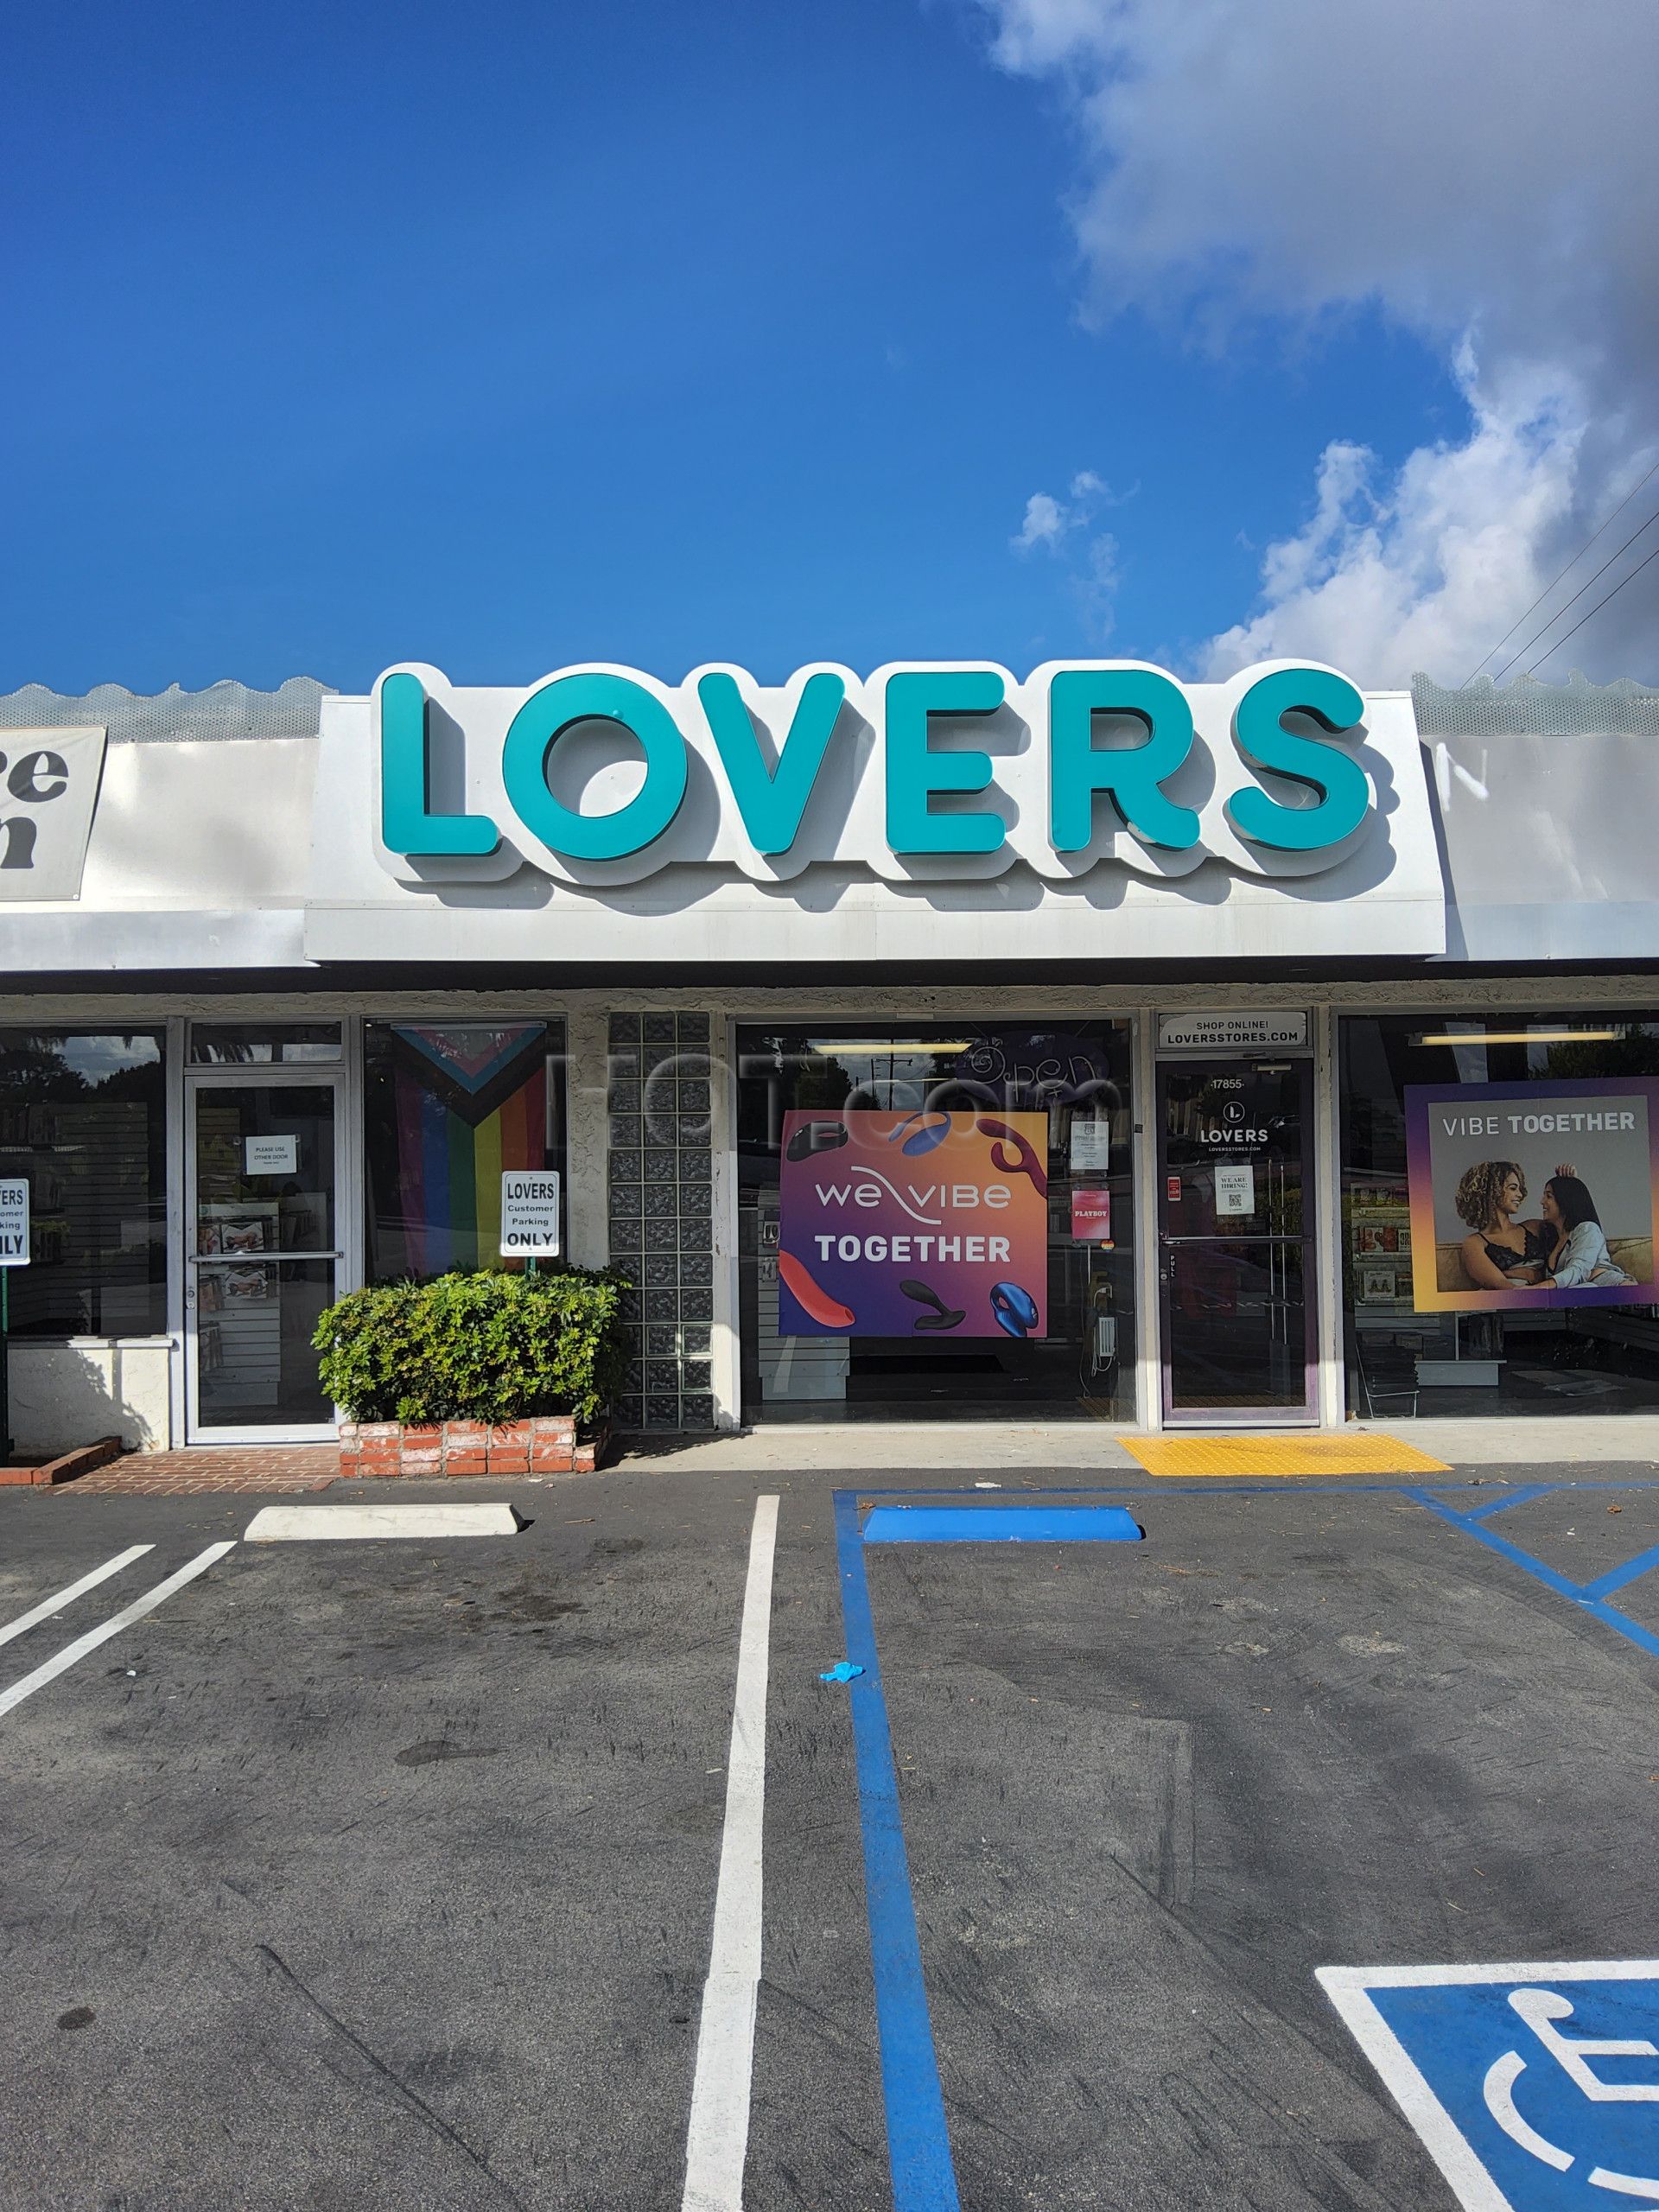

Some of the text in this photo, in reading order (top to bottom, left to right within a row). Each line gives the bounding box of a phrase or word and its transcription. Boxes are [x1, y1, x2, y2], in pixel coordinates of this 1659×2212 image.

[381, 669, 1370, 861] LOVERS
[0, 750, 69, 803] e
[1196, 1021, 1225, 1030] SHOP
[1167, 1032, 1298, 1044] LOVERSSTORES.COM
[1442, 1112, 1636, 1136] VIBE TOGETHER
[1200, 1129, 1268, 1143] LOVERS
[0, 1189, 23, 1205] ERS
[507, 1183, 554, 1199] LOVERS
[512, 1217, 549, 1226] Parking
[507, 1232, 553, 1246] ONLY
[815, 1235, 1011, 1262] TOGETHER
